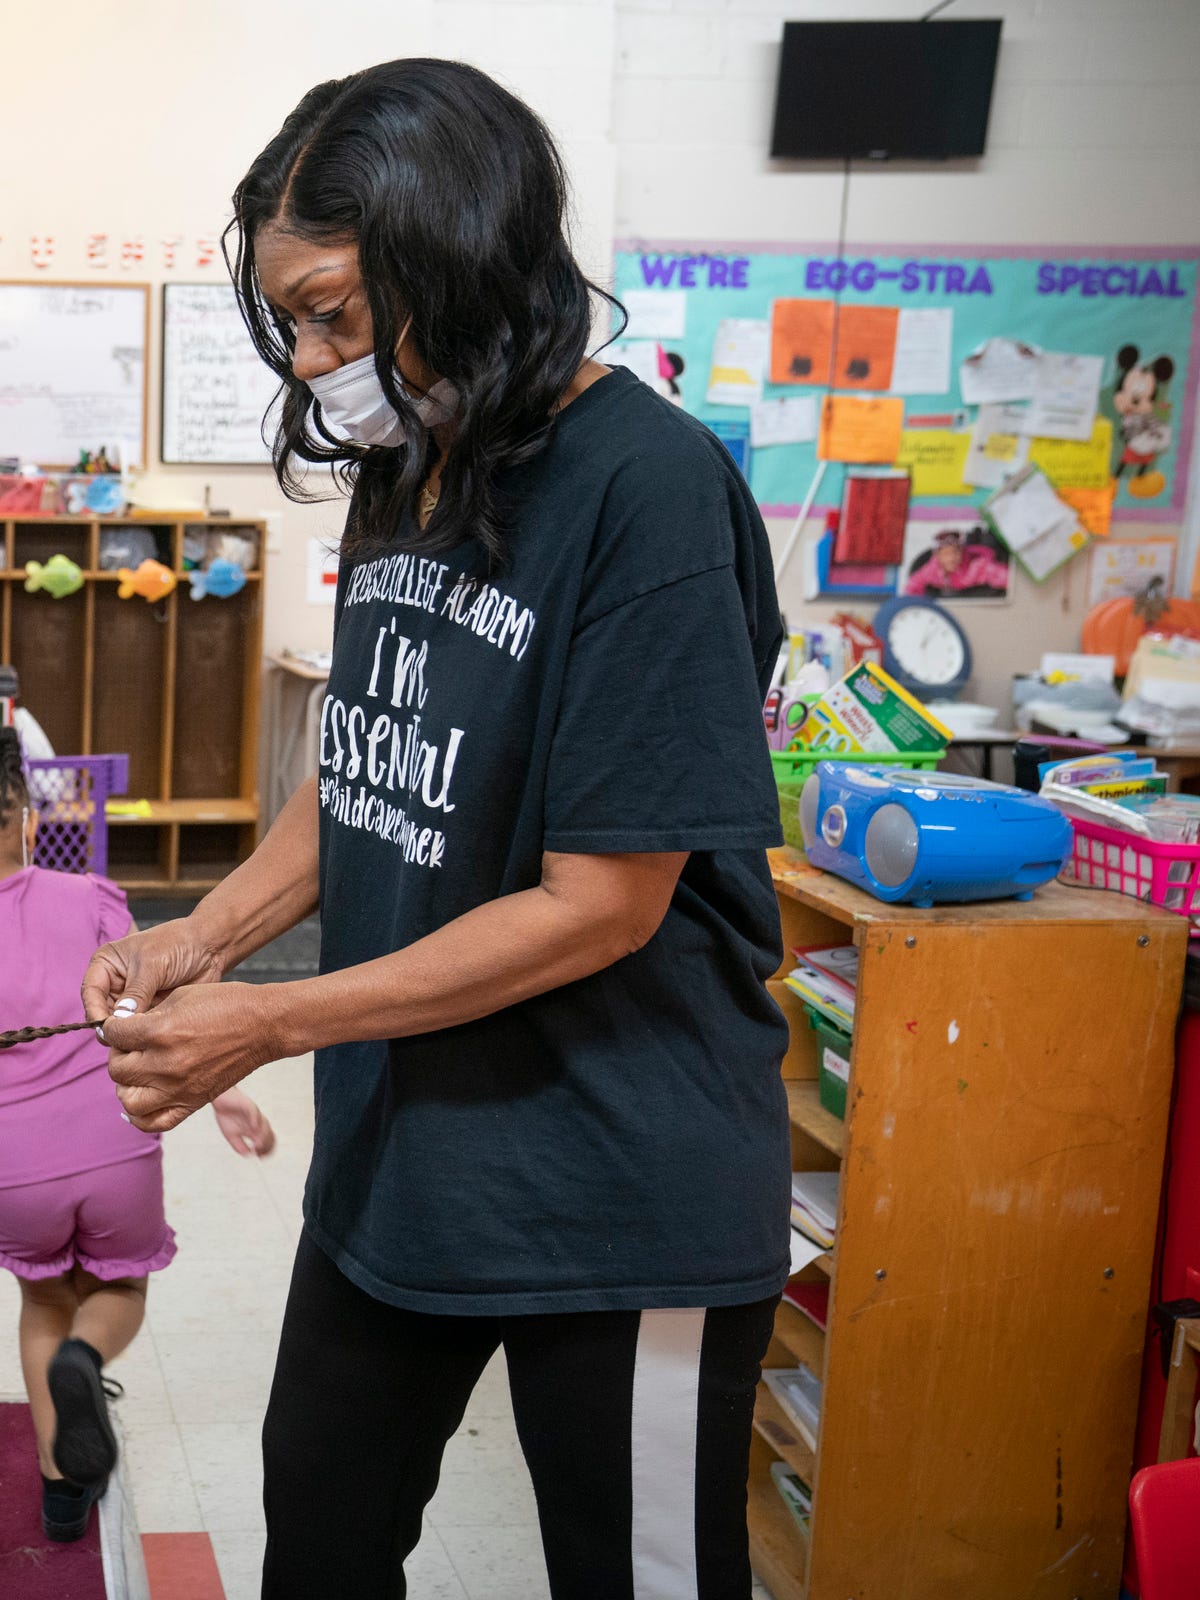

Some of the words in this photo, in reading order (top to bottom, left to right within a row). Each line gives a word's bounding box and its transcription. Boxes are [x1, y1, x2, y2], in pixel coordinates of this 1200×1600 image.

[640, 254, 750, 289] WE'RE
[804, 259, 993, 296] EGG-STRA
[1036, 262, 1188, 299] SPECIAL
[440, 571, 536, 662] ACADEMY
